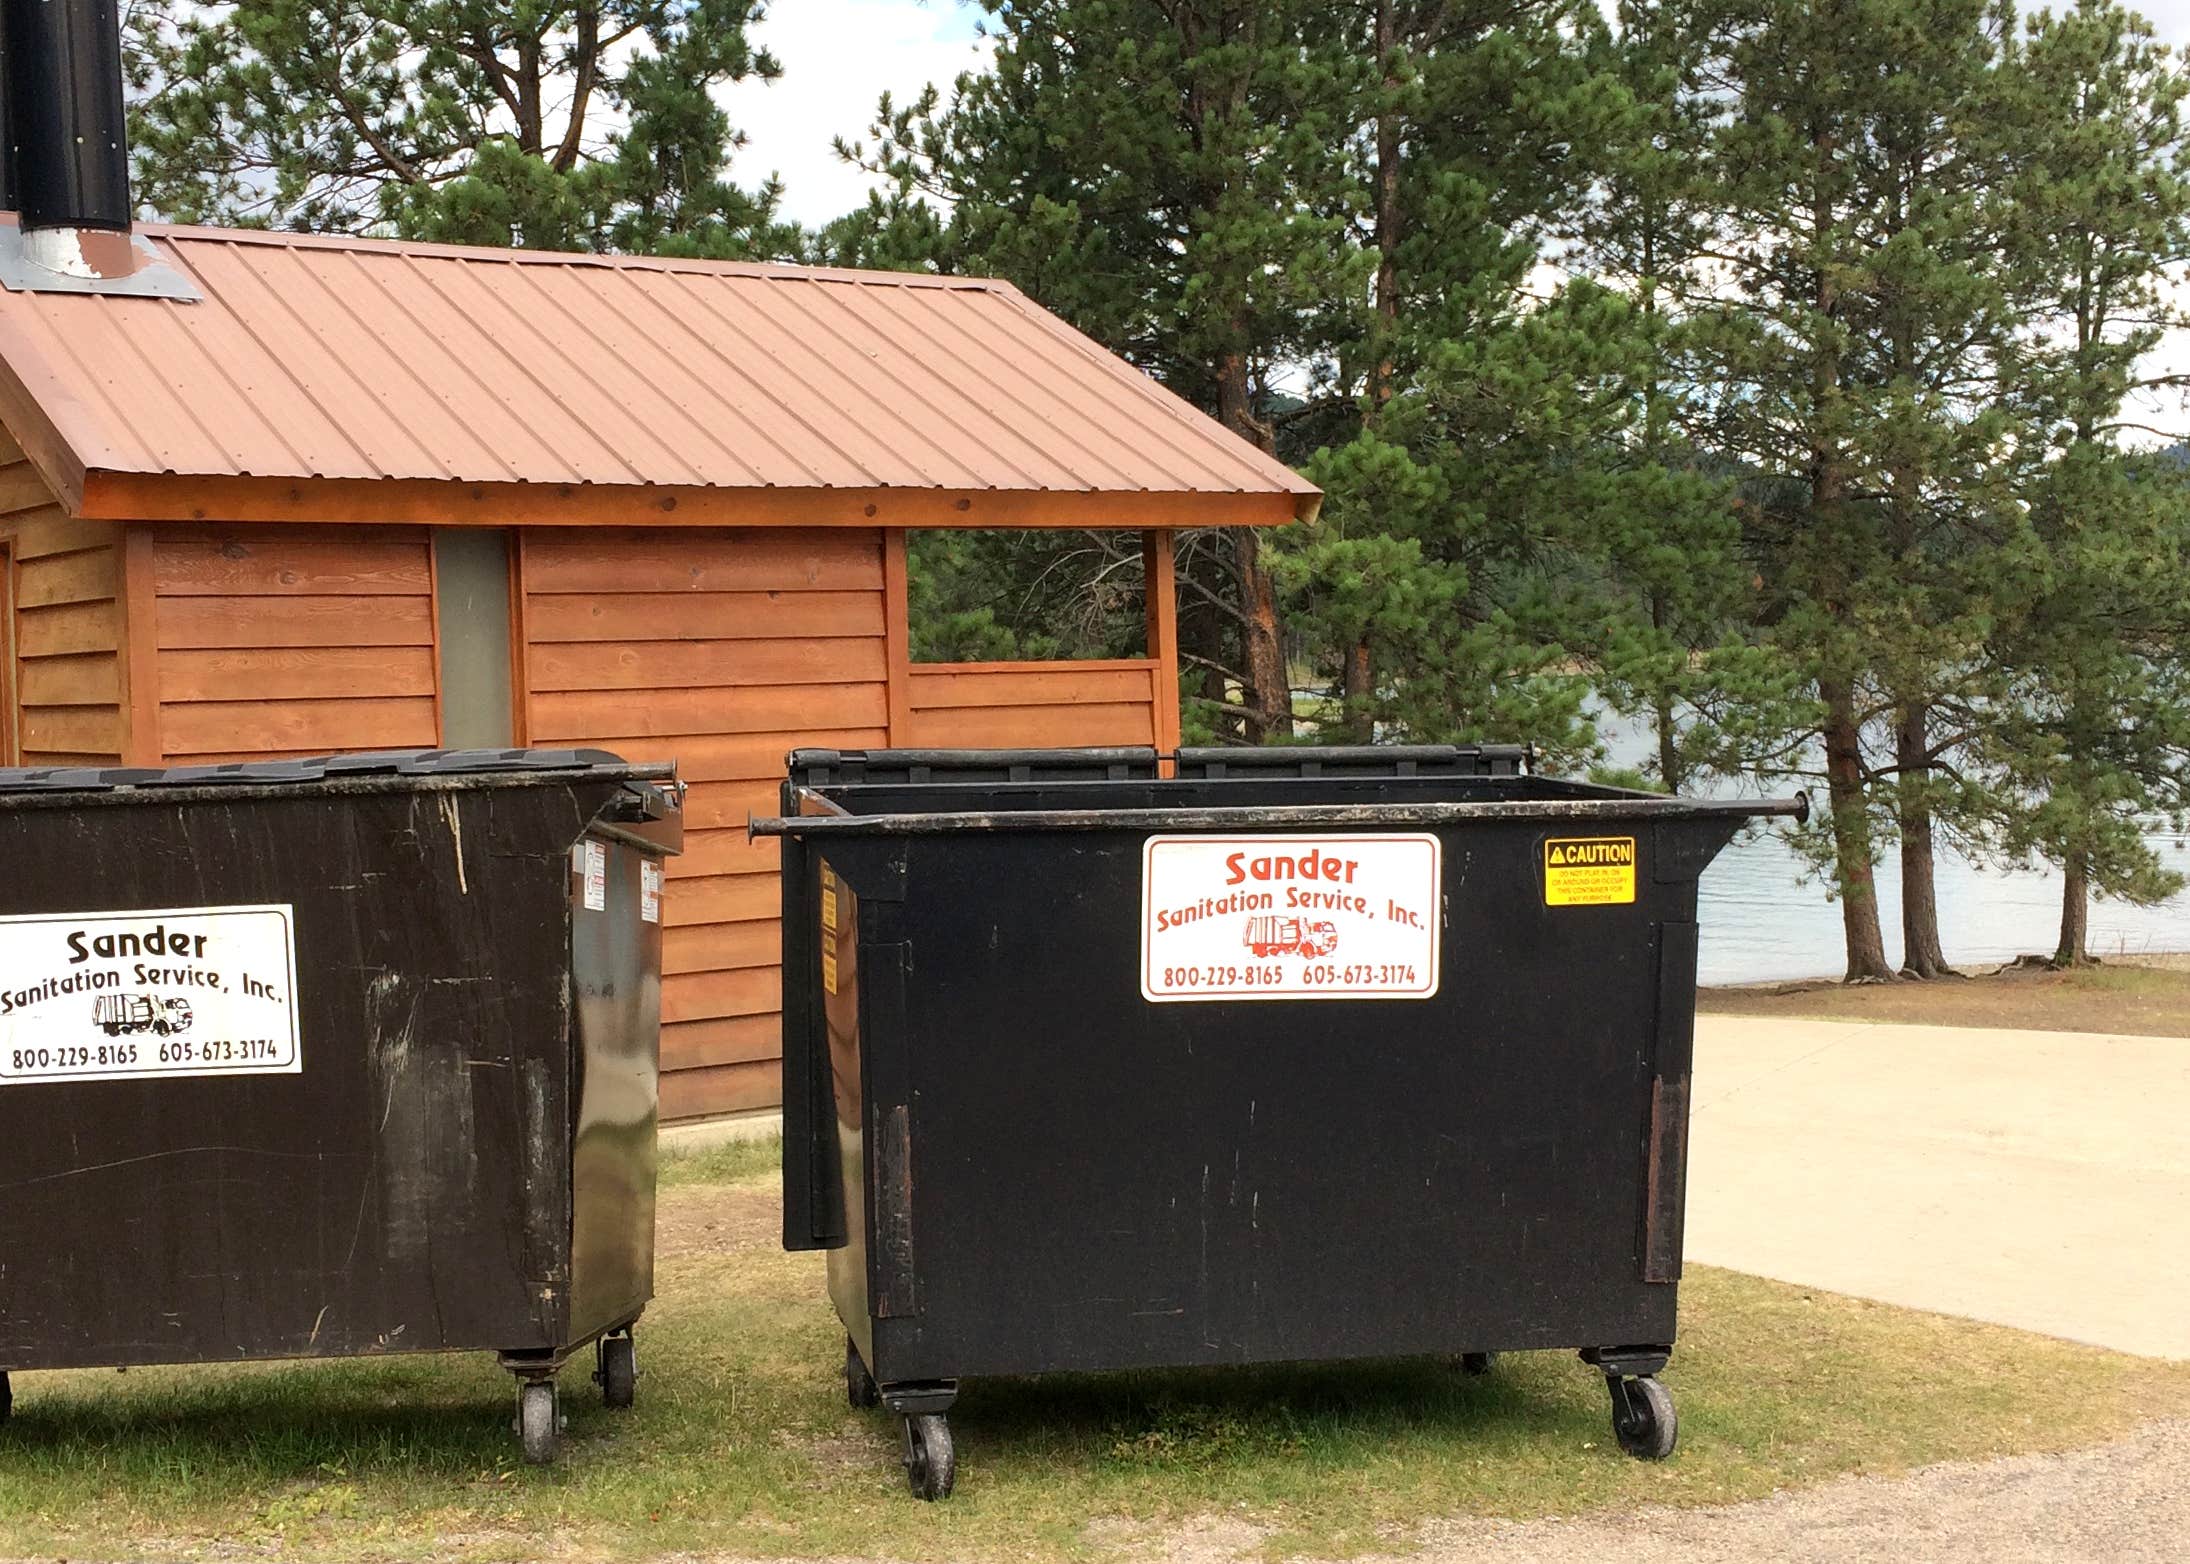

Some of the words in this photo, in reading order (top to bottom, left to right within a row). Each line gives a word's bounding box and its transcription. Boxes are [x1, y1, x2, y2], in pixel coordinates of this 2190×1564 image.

[1225, 848, 1359, 886] Sander
[1566, 844, 1630, 864] CAUTION
[1157, 890, 1273, 933] Sanitation
[1286, 887, 1375, 919] Service,
[1388, 899, 1425, 931] Inc.
[66, 925, 208, 964] Sander
[1, 969, 120, 1015] Sanitation
[134, 963, 230, 994] Service,
[243, 973, 283, 1003] Inc.
[1164, 965, 1283, 987] 800-229-8165
[1303, 965, 1416, 985] 605-673-3174
[12, 1045, 138, 1069] 800-229-8165
[159, 1039, 277, 1063] 605-673-3174
